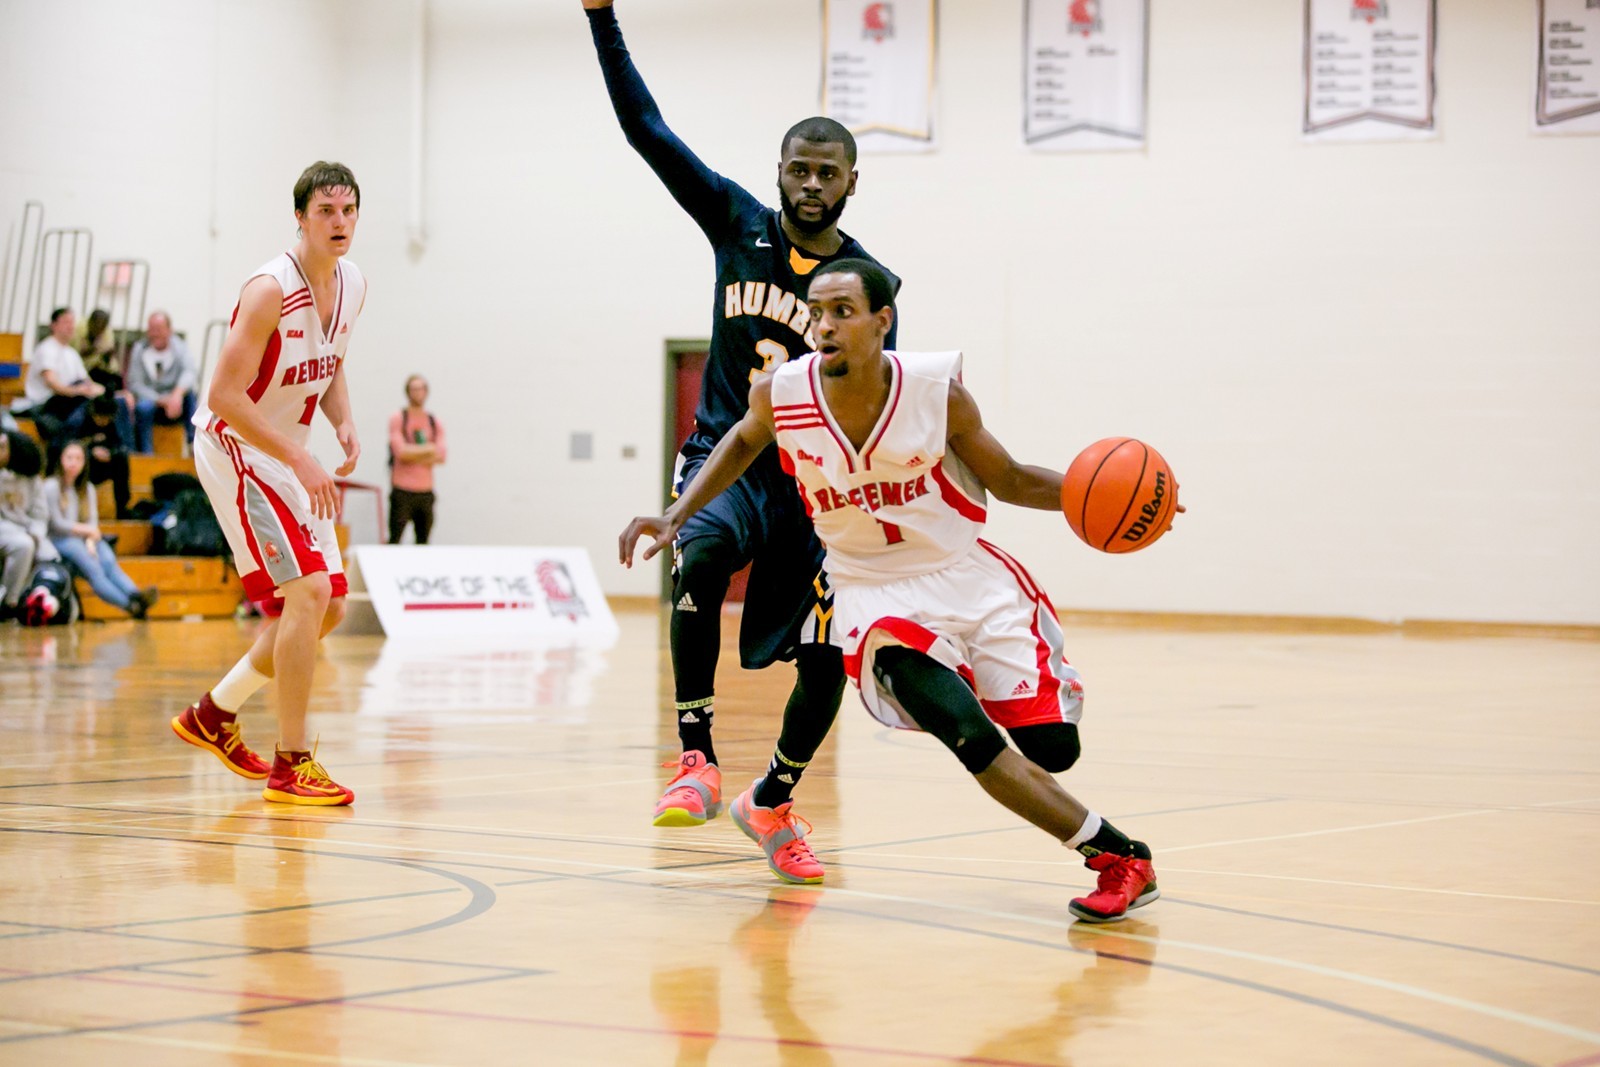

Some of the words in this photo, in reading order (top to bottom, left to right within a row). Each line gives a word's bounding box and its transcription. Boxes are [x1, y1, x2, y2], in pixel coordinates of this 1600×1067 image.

[725, 281, 817, 351] HUMB
[298, 393, 319, 426] 1
[813, 474, 931, 513] REEEMER
[1121, 470, 1166, 542] Wilson
[397, 576, 455, 597] HOME
[461, 576, 486, 597] OF
[492, 576, 534, 597] THE
